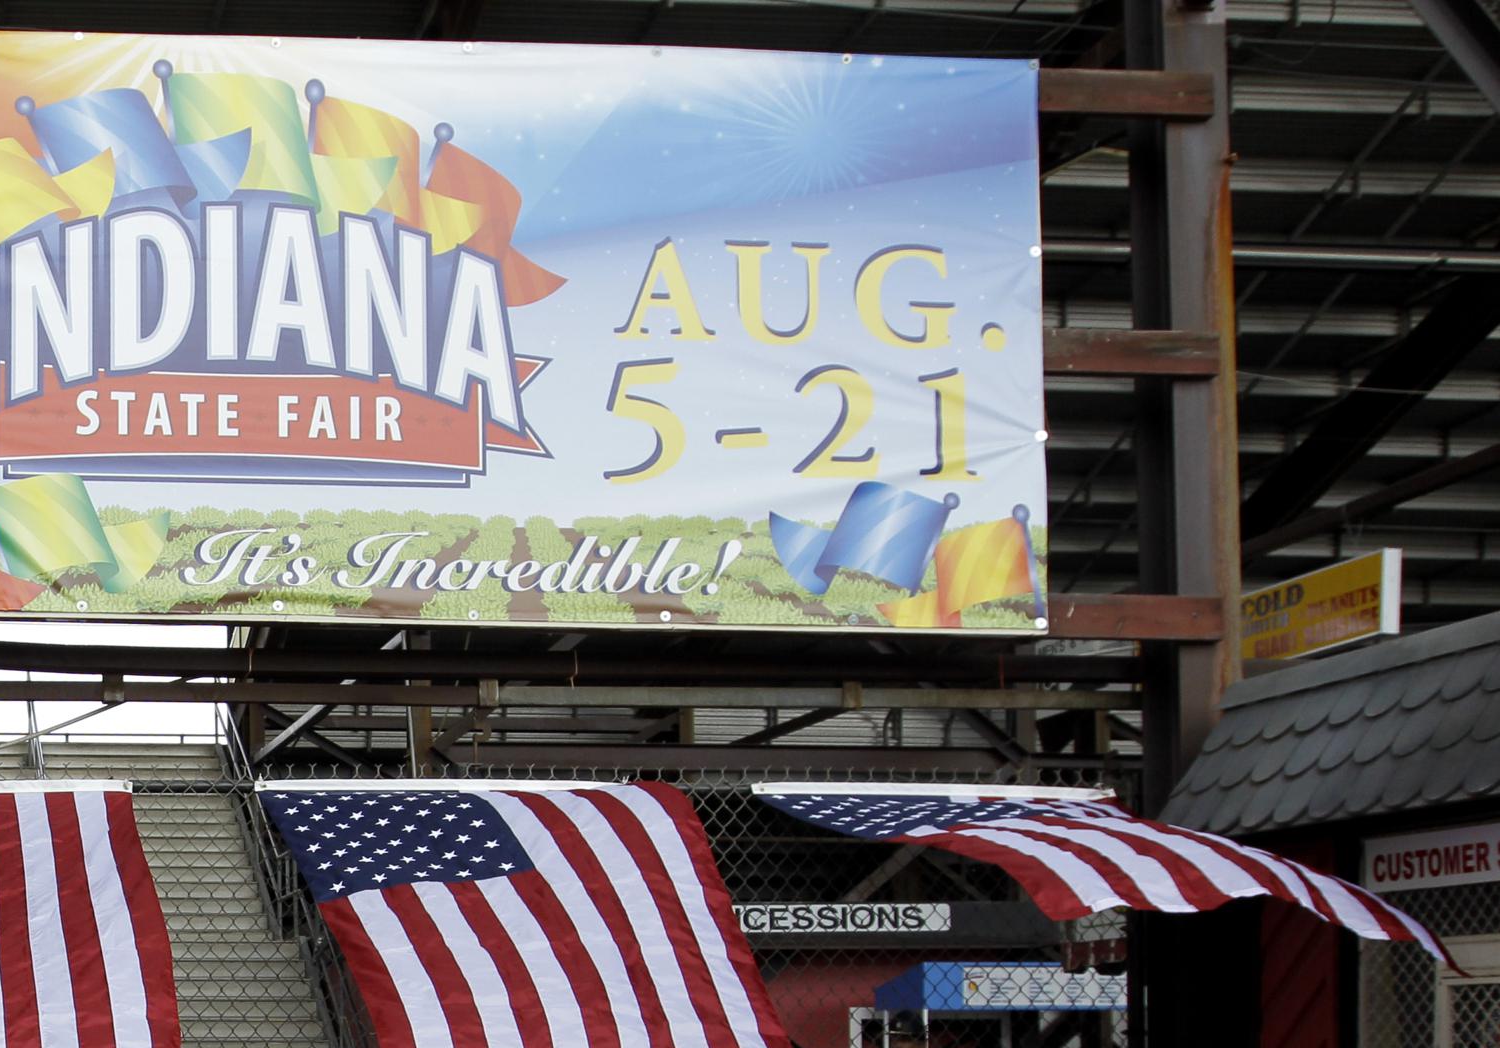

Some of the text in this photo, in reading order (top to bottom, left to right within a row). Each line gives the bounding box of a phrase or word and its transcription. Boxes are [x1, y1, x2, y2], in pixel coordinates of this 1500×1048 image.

[613, 235, 1007, 352] AUG.
[75, 388, 404, 442] STATE FAIR
[603, 356, 985, 484] 5-21
[183, 527, 743, 596] It's Incredible!
[1242, 583, 1305, 620] COLD
[1372, 841, 1492, 882] CUSTOMER
